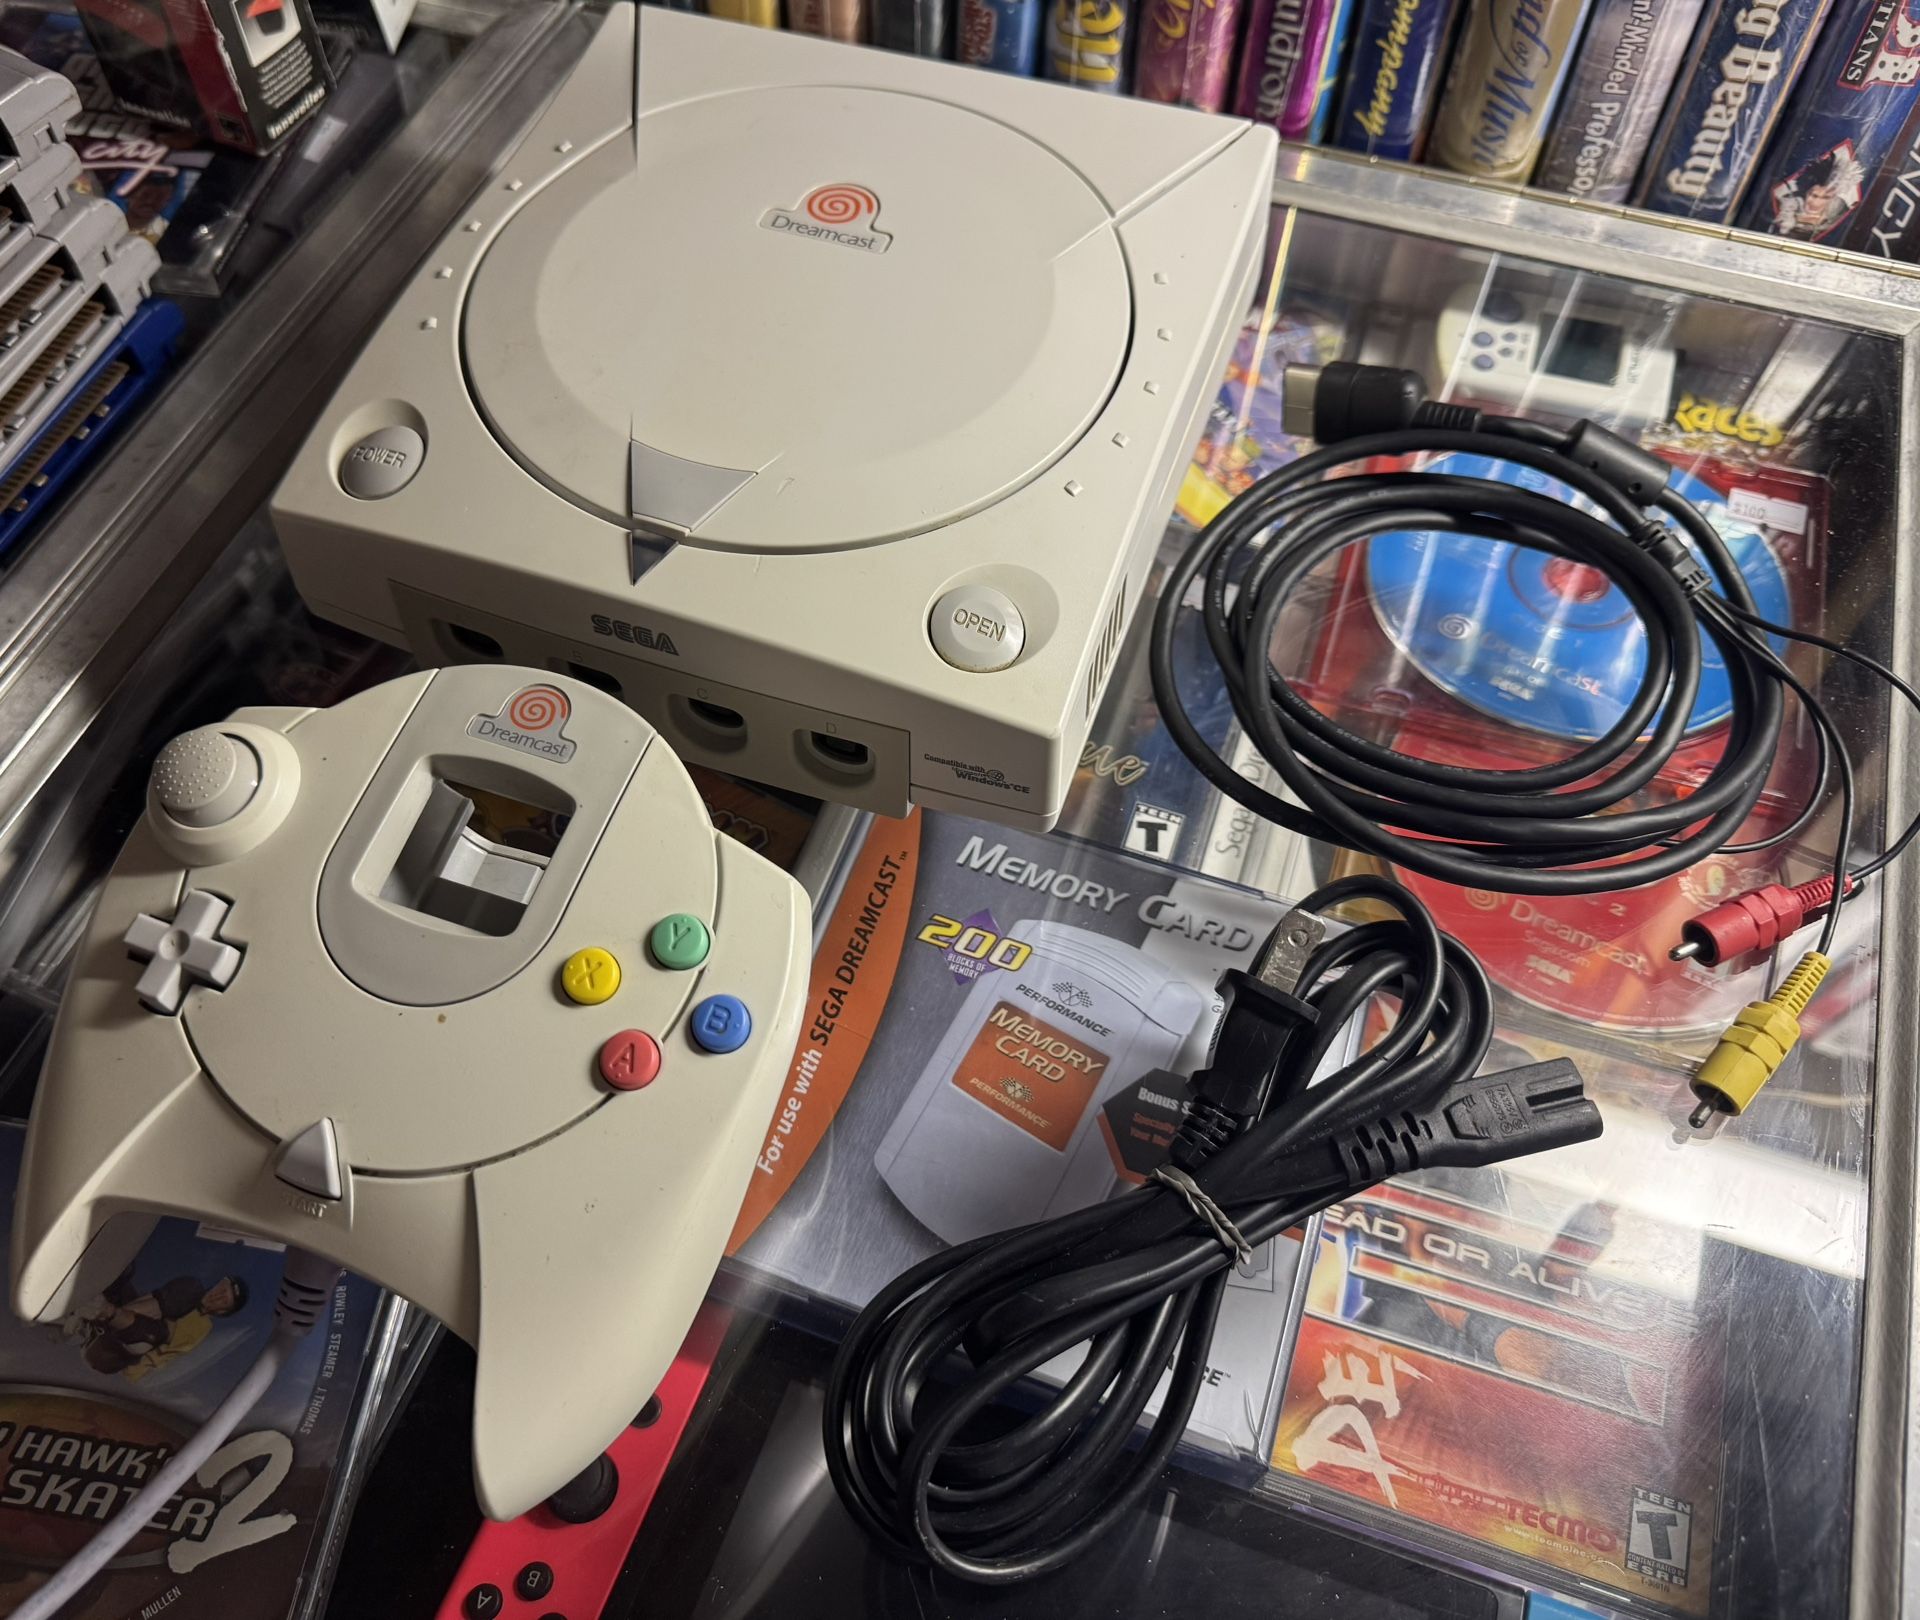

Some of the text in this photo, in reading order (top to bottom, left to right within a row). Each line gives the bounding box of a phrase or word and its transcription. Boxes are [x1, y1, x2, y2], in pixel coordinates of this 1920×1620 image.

[1470, 68, 1536, 169] Music
[1667, 43, 1782, 197] Beauty
[1566, 102, 1622, 196] Professor
[770, 214, 877, 250] Dreamcast
[351, 446, 407, 469] POWER
[590, 613, 680, 657] SEGA
[951, 608, 1006, 642] OPEN
[477, 719, 569, 758] Dreamcast
[923, 753, 968, 770] Compatible
[968, 763, 986, 774] with
[954, 768, 1011, 790] Windows
[1136, 803, 1183, 825] TEEN
[1136, 820, 1169, 852] T
[956, 834, 1256, 953] MEMORY CARD
[668, 922, 692, 951] Y
[915, 913, 1033, 972] 200
[1509, 898, 1653, 975] Dreamcast
[572, 957, 603, 990] X
[947, 953, 986, 972] BLOCKS OF
[949, 963, 981, 979] MEMORY
[703, 1003, 732, 1035] B
[757, 1131, 784, 1175] For
[776, 1096, 803, 1135] use
[793, 1047, 823, 1095] with
[809, 987, 849, 1046] SEGA
[835, 854, 902, 985] DREAMCAST
[1015, 983, 1112, 1038] PERFORMANCE
[609, 1042, 636, 1075] A
[989, 1007, 1105, 1076] MEMORY
[995, 1035, 1066, 1083] CARD
[969, 1077, 1050, 1128] PERFORMANCE
[1137, 1086, 1179, 1111] Bonus
[1422, 1232, 1492, 1270] OR
[333, 1284, 348, 1325] ROWLEY
[321, 1332, 342, 1379] STEAMER
[13, 1430, 174, 1481] HAWK'
[166, 1428, 298, 1574] 2
[1634, 1486, 1692, 1514] TEEN
[1503, 1496, 1617, 1553] TECMO
[1635, 1510, 1679, 1560] T
[526, 1569, 542, 1588] B
[1626, 1560, 1686, 1587] ESRB
[140, 1584, 183, 1620] MULLEN
[476, 1590, 493, 1610] A
